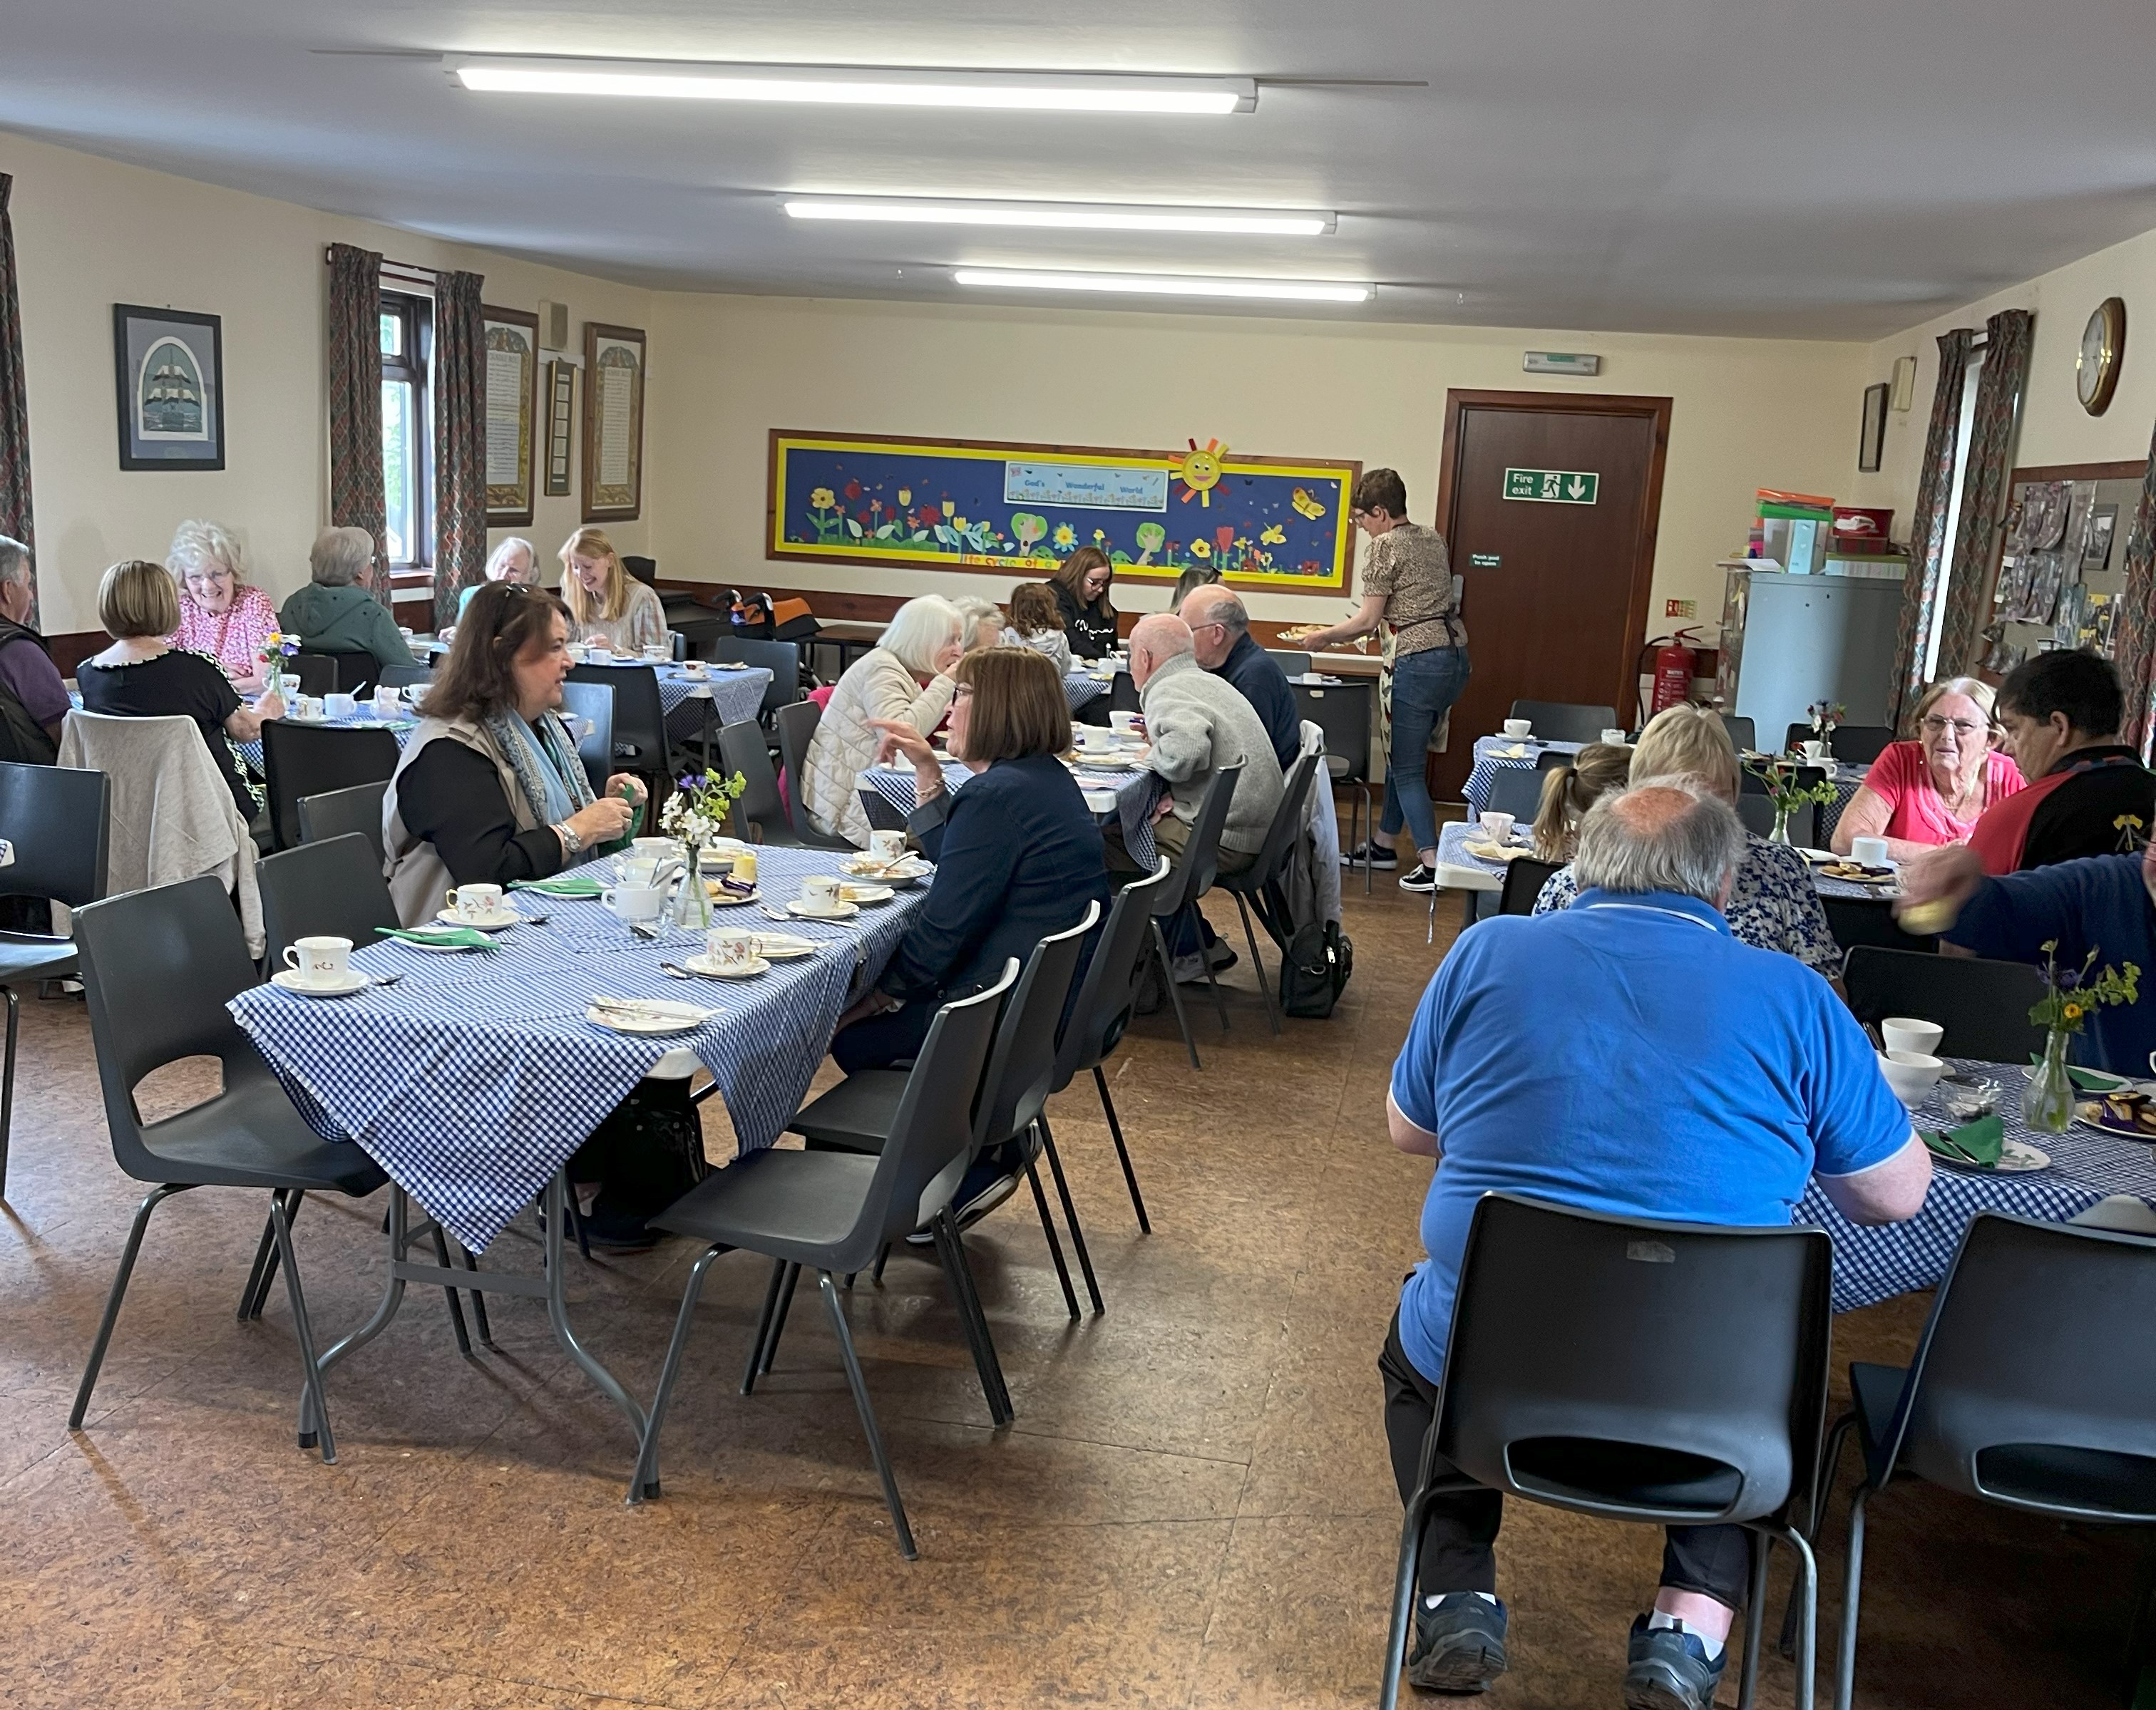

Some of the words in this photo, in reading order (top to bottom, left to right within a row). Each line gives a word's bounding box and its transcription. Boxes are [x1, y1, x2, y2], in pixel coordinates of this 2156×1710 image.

[1513, 473, 1534, 484] Fire
[1065, 481, 1105, 492] Wonderful
[1119, 486, 1144, 495] World
[1511, 485, 1532, 495] exit
